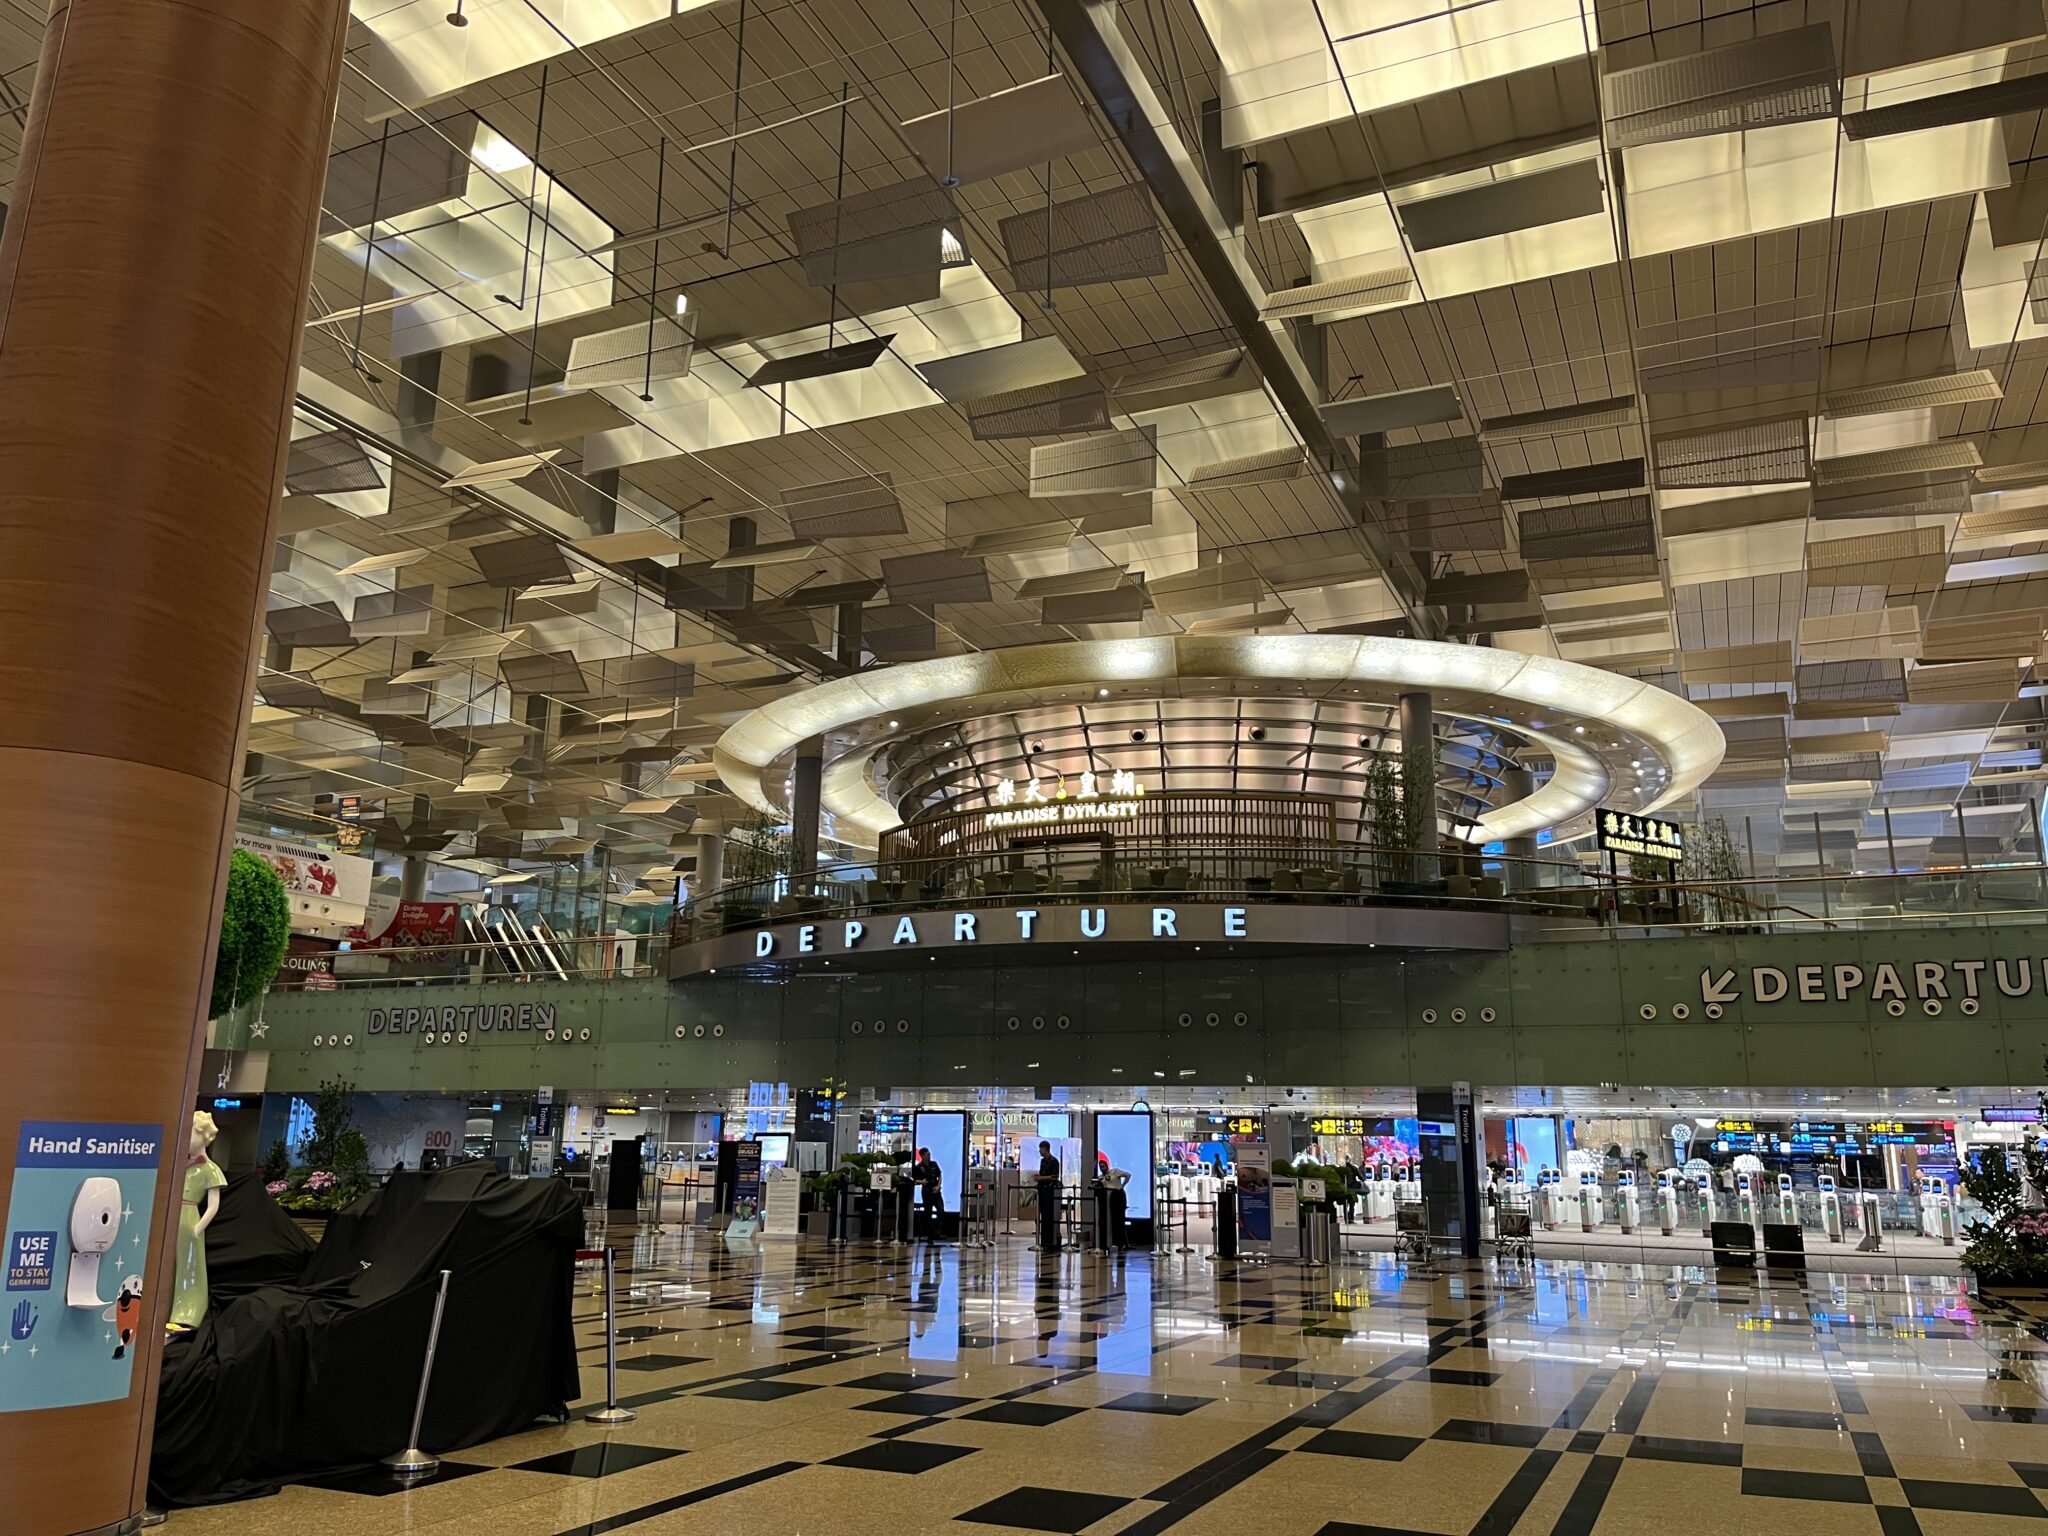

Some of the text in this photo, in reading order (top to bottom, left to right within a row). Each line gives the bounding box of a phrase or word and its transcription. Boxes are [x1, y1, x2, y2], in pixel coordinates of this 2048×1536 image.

[985, 802, 1140, 827] PARADISE DYNASTY
[241, 838, 251, 846] for
[252, 841, 272, 850] more
[1604, 836, 1682, 860] PARADISE DYNASTY
[402, 911, 429, 920] Delights
[403, 904, 424, 913] Dining
[756, 906, 1248, 957] DEPARTURE
[368, 1003, 532, 1034] DEPARTURE
[538, 1106, 548, 1134] Trolleys
[28, 1136, 156, 1155] Hand Sanitiser
[20, 1236, 50, 1250] USE
[19, 1253, 45, 1267] ME
[11, 1268, 50, 1278] TO STAY
[32, 1278, 49, 1286] FREE
